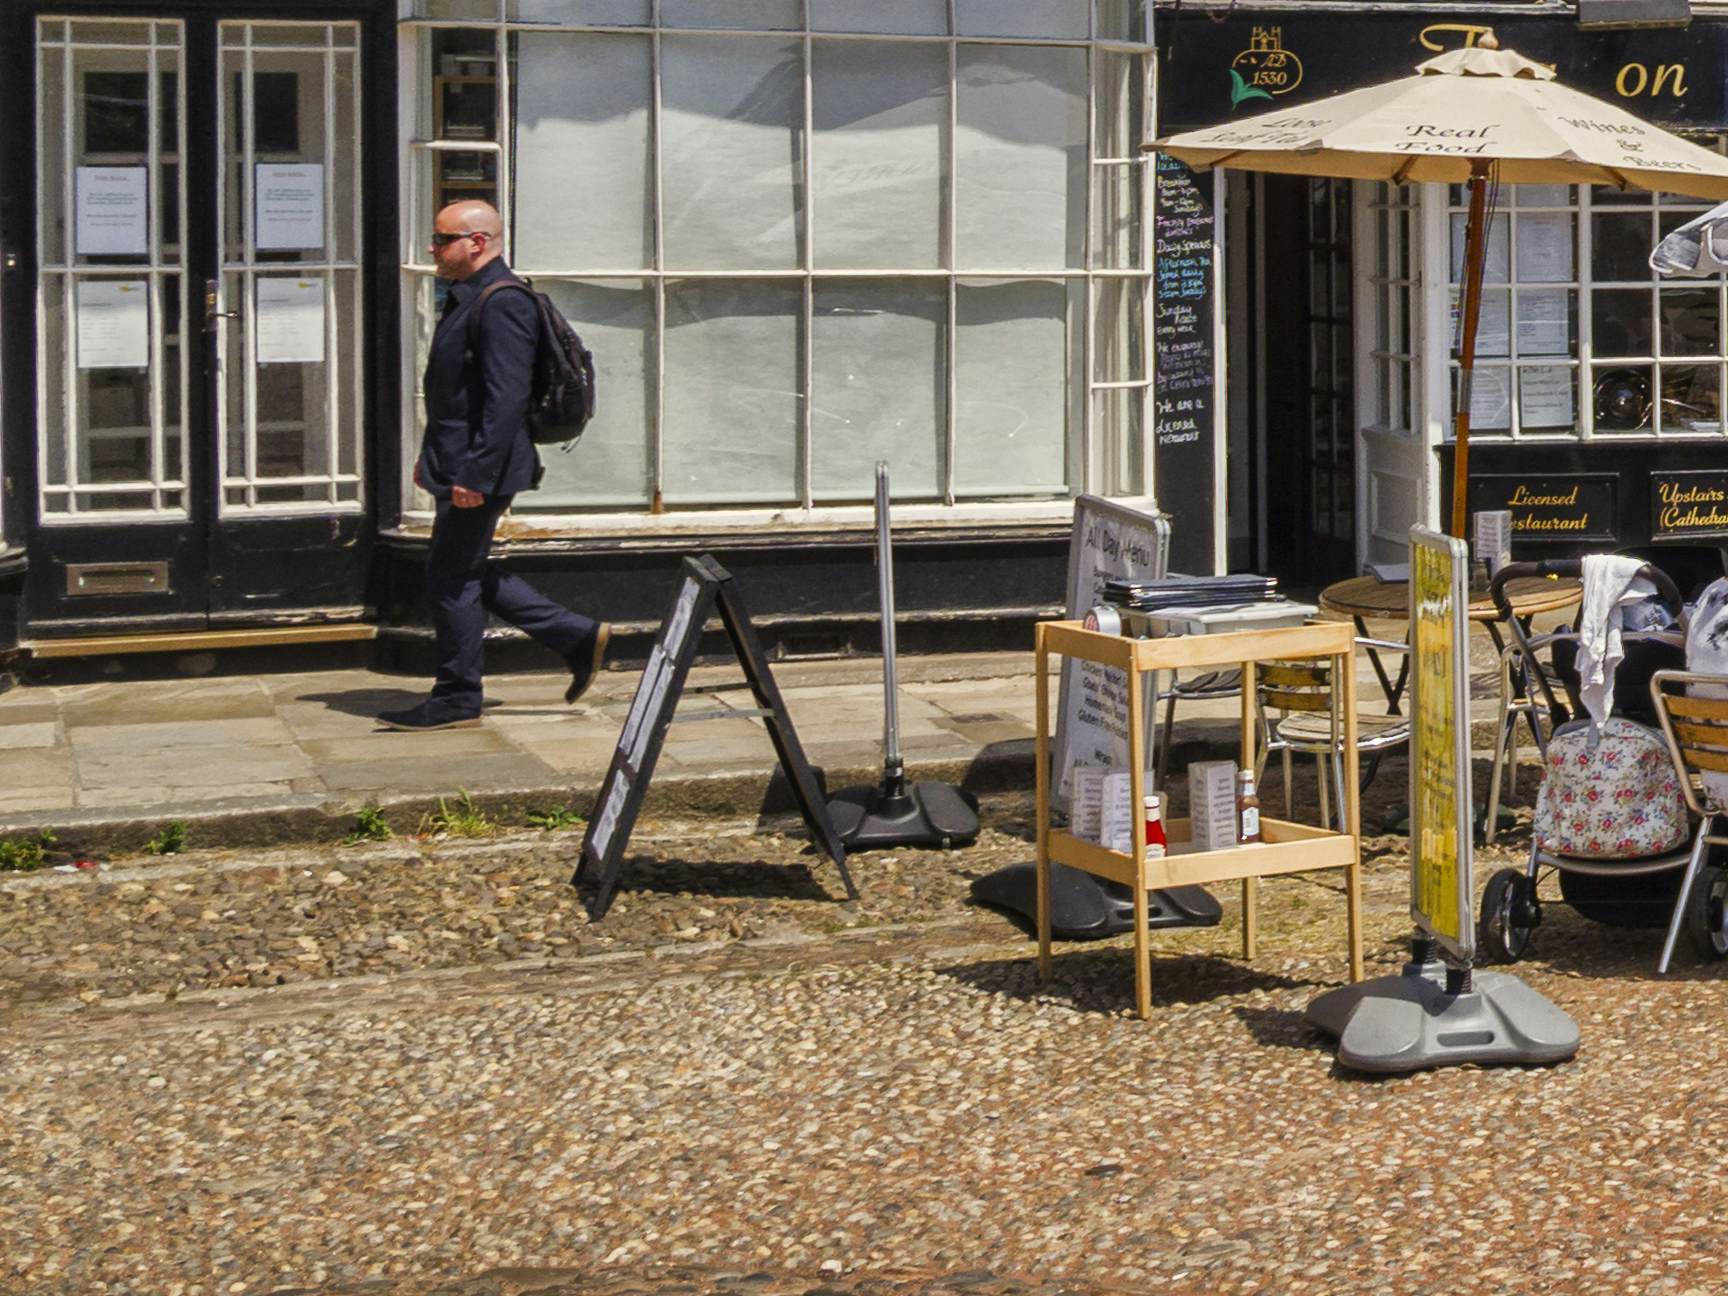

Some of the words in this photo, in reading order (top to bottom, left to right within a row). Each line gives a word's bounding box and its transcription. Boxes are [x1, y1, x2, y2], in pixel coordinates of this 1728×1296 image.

[1251, 71, 1288, 86] 1530
[1615, 61, 1688, 99] on
[1405, 124, 1500, 139] Real
[1395, 141, 1498, 154] Food
[1506, 484, 1578, 506] Licensed
[1658, 482, 1725, 506] Upstairs
[1510, 512, 1588, 530] estaurant
[1103, 529, 1120, 562] Day
